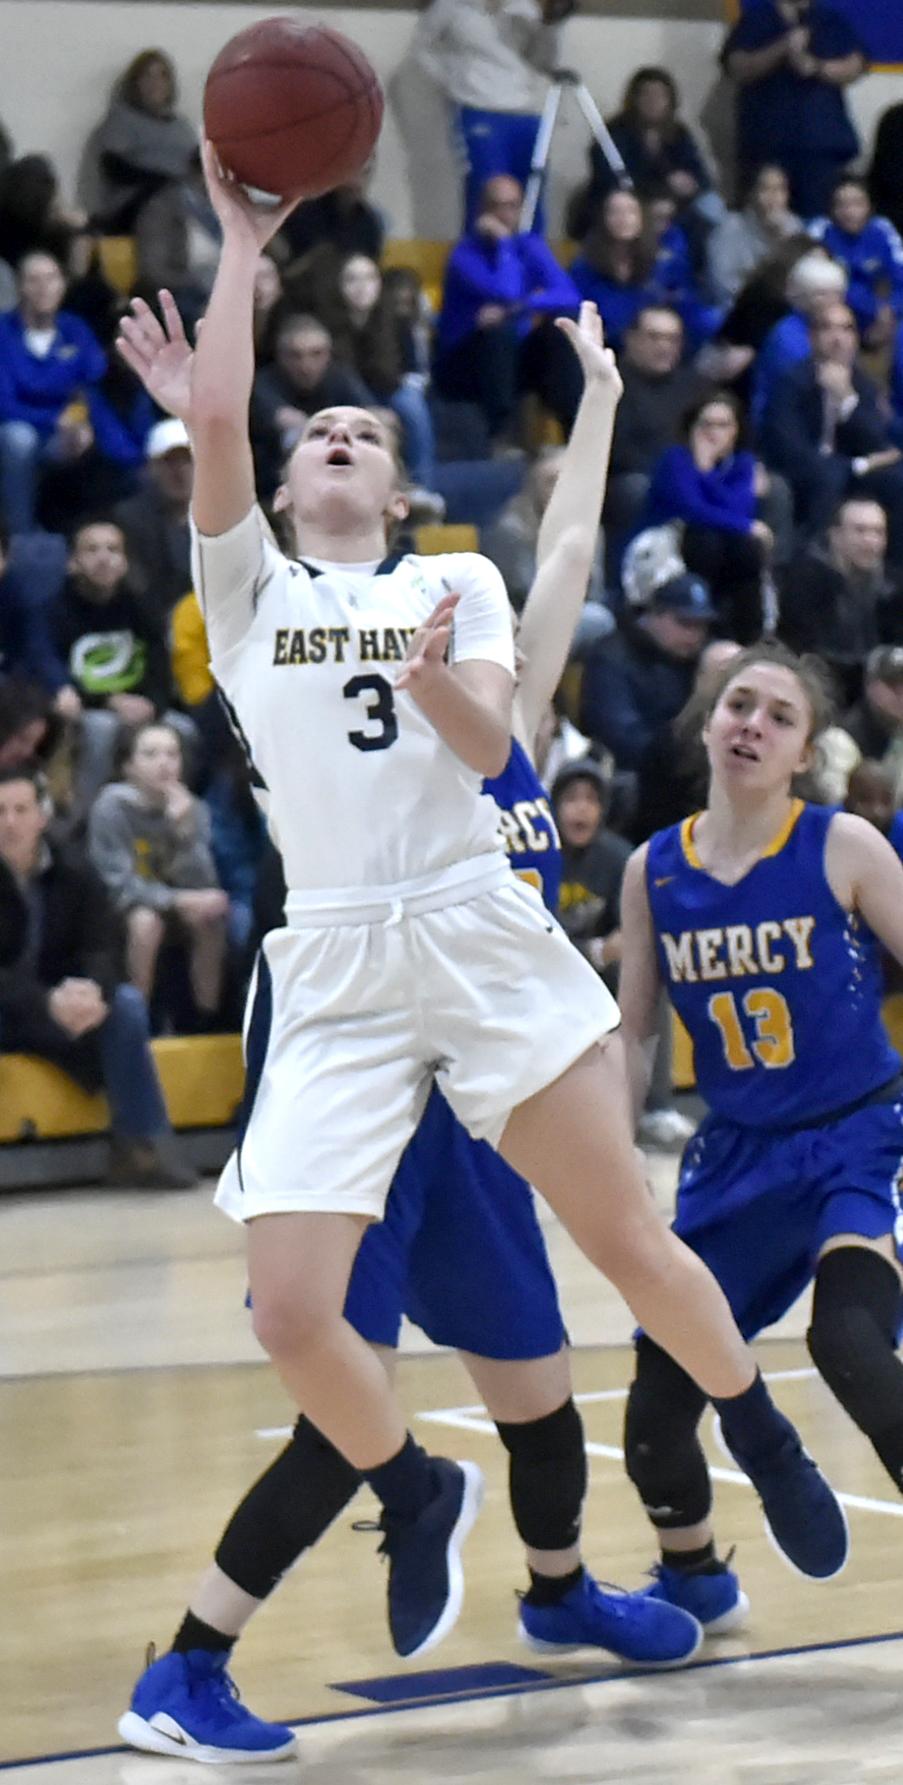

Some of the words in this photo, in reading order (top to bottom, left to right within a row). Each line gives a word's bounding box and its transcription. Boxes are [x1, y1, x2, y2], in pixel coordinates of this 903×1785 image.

[273, 628, 349, 665] EAST
[358, 627, 449, 664] HAV
[343, 673, 398, 752] 3
[500, 797, 562, 854] RCY
[660, 916, 815, 983] MERCY
[708, 987, 795, 1070] 13
